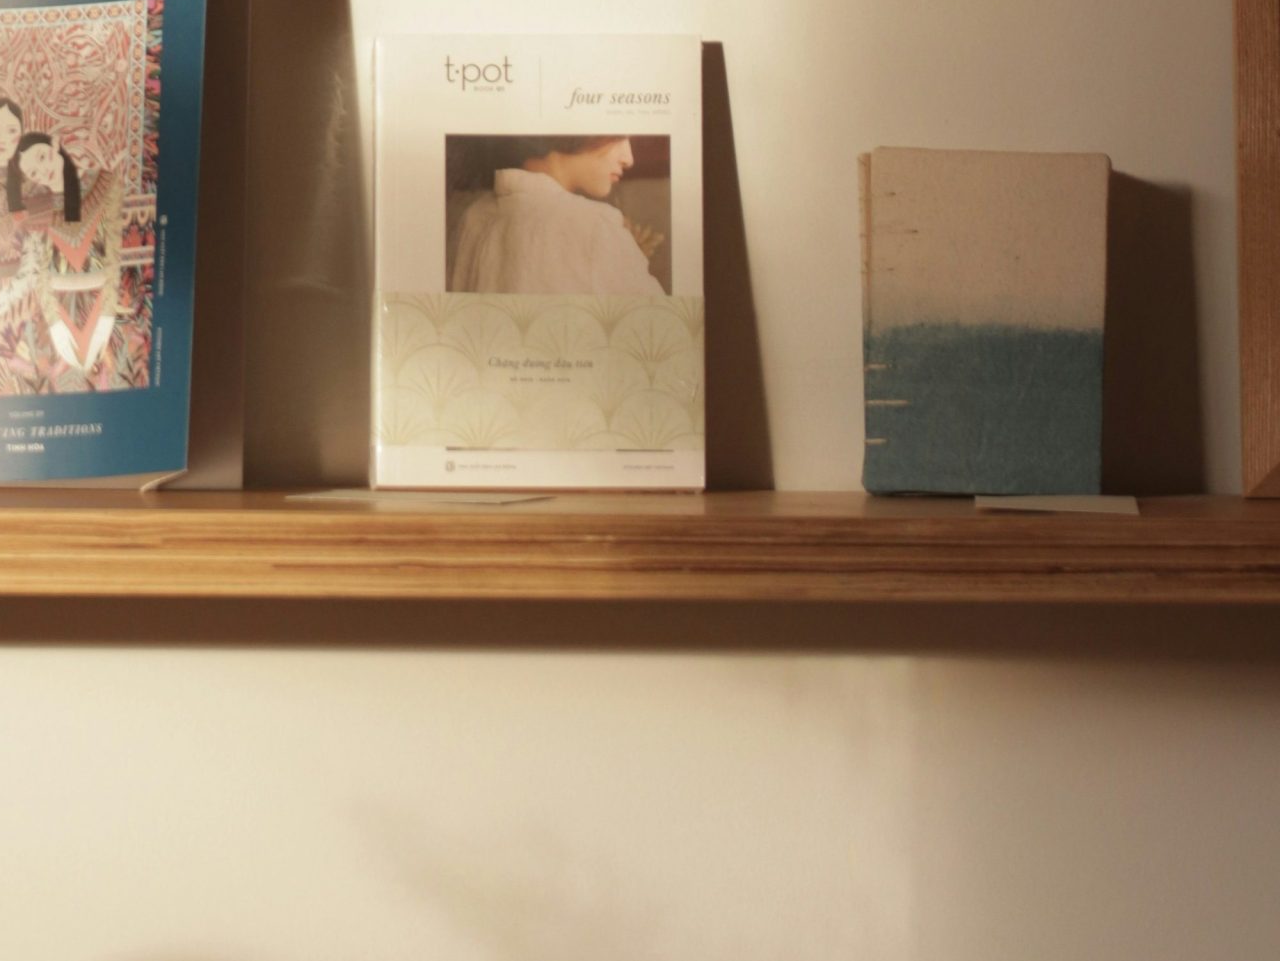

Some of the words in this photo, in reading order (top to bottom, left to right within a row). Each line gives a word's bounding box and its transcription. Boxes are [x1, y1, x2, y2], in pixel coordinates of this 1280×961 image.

[563, 86, 604, 110] four
[608, 90, 672, 106] seasons
[30, 423, 104, 438] TRADITIONS
